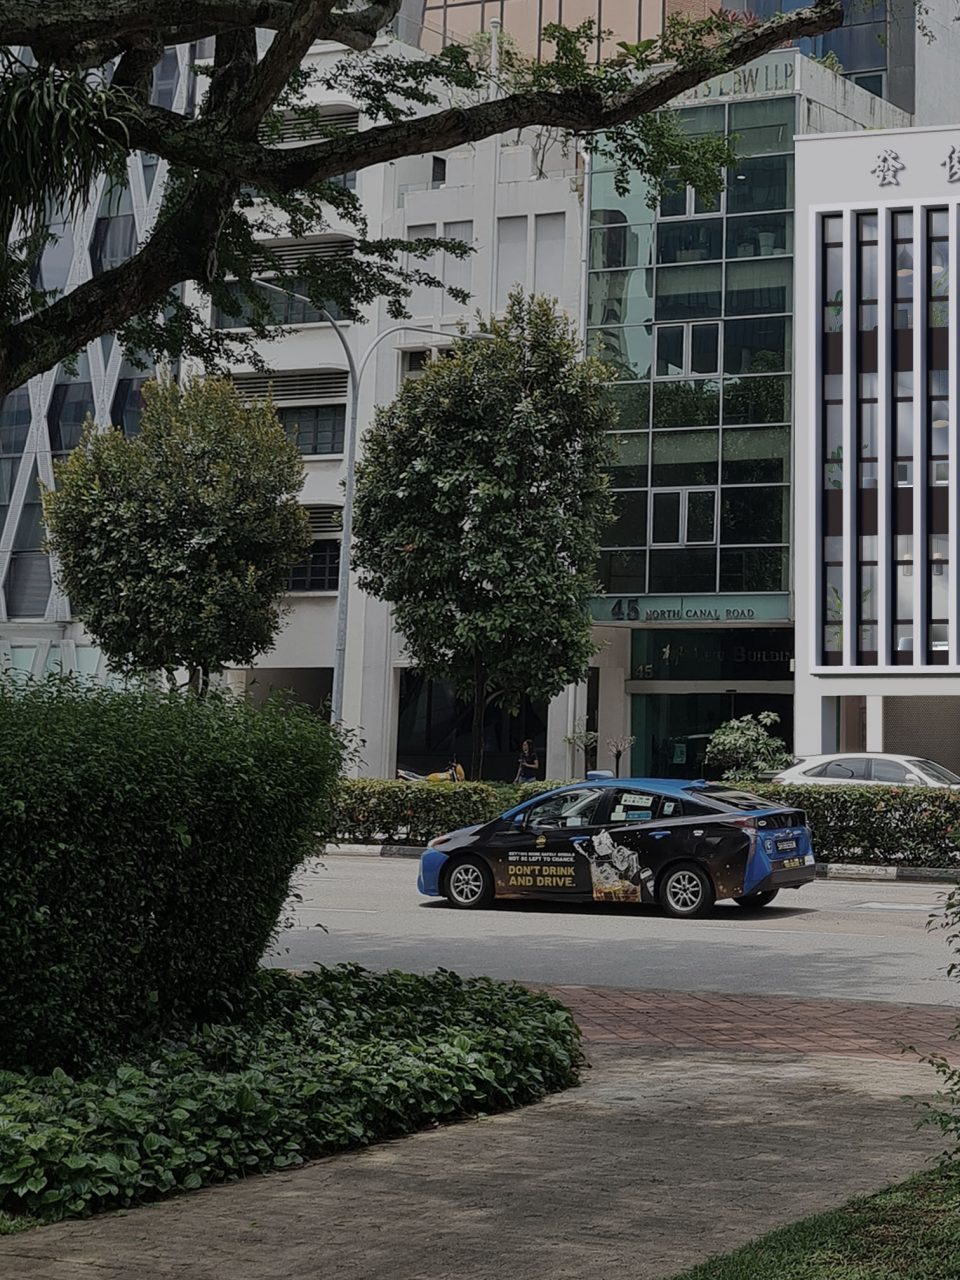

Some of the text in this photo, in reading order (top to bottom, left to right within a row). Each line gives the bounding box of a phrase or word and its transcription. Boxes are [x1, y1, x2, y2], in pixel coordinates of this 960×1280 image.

[765, 62, 794, 91] LLP
[611, 598, 755, 621] 45 NORTH CANAL ROAD
[635, 664, 654, 679] 45
[508, 865, 575, 876] DON'T DRINK
[509, 876, 576, 887] AND DRIVE.
